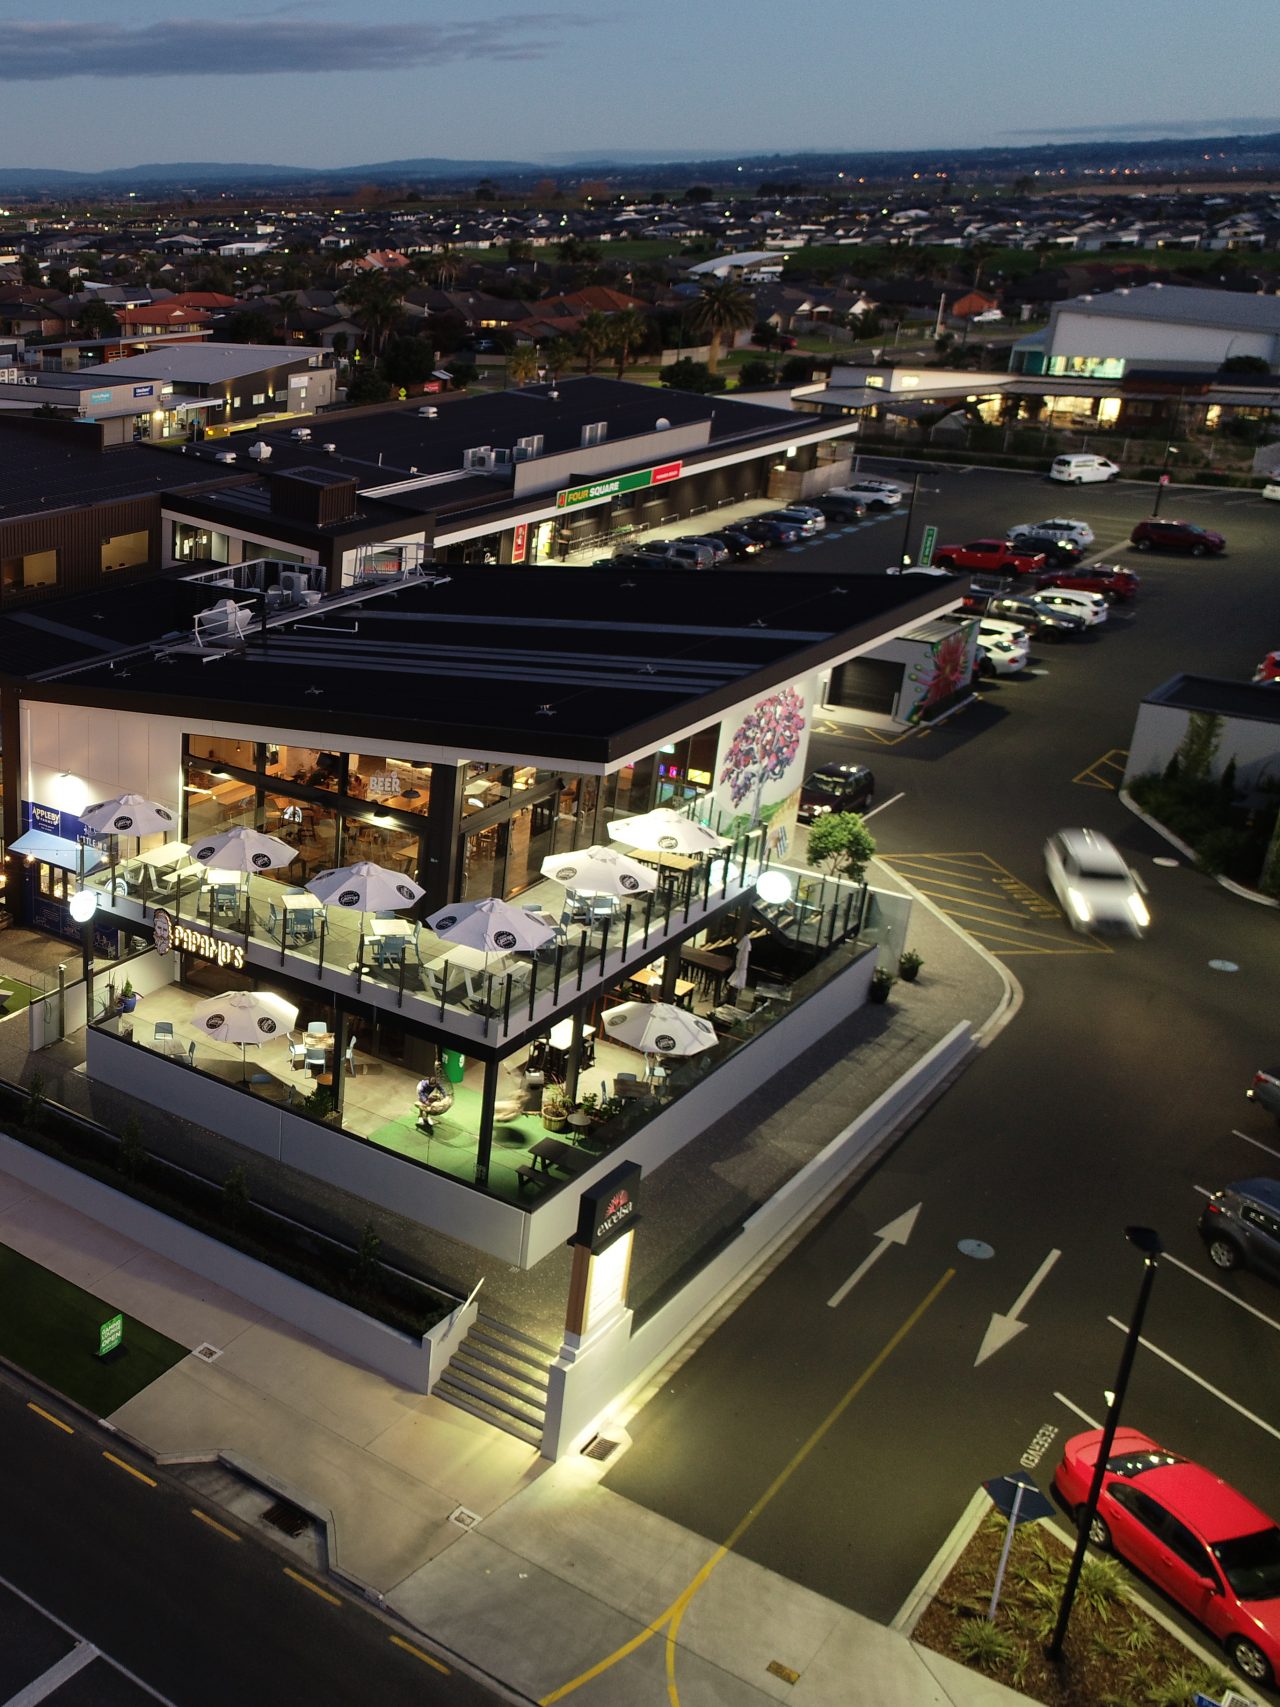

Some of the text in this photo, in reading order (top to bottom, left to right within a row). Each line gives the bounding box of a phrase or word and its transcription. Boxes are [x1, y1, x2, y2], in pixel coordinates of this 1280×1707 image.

[568, 481, 620, 503] FOUR SQUARE
[370, 776, 401, 792] BEER
[32, 806, 59, 824] APPLEBY
[102, 1330, 121, 1347] OPEN
[1020, 1423, 1059, 1469] RESERVED
